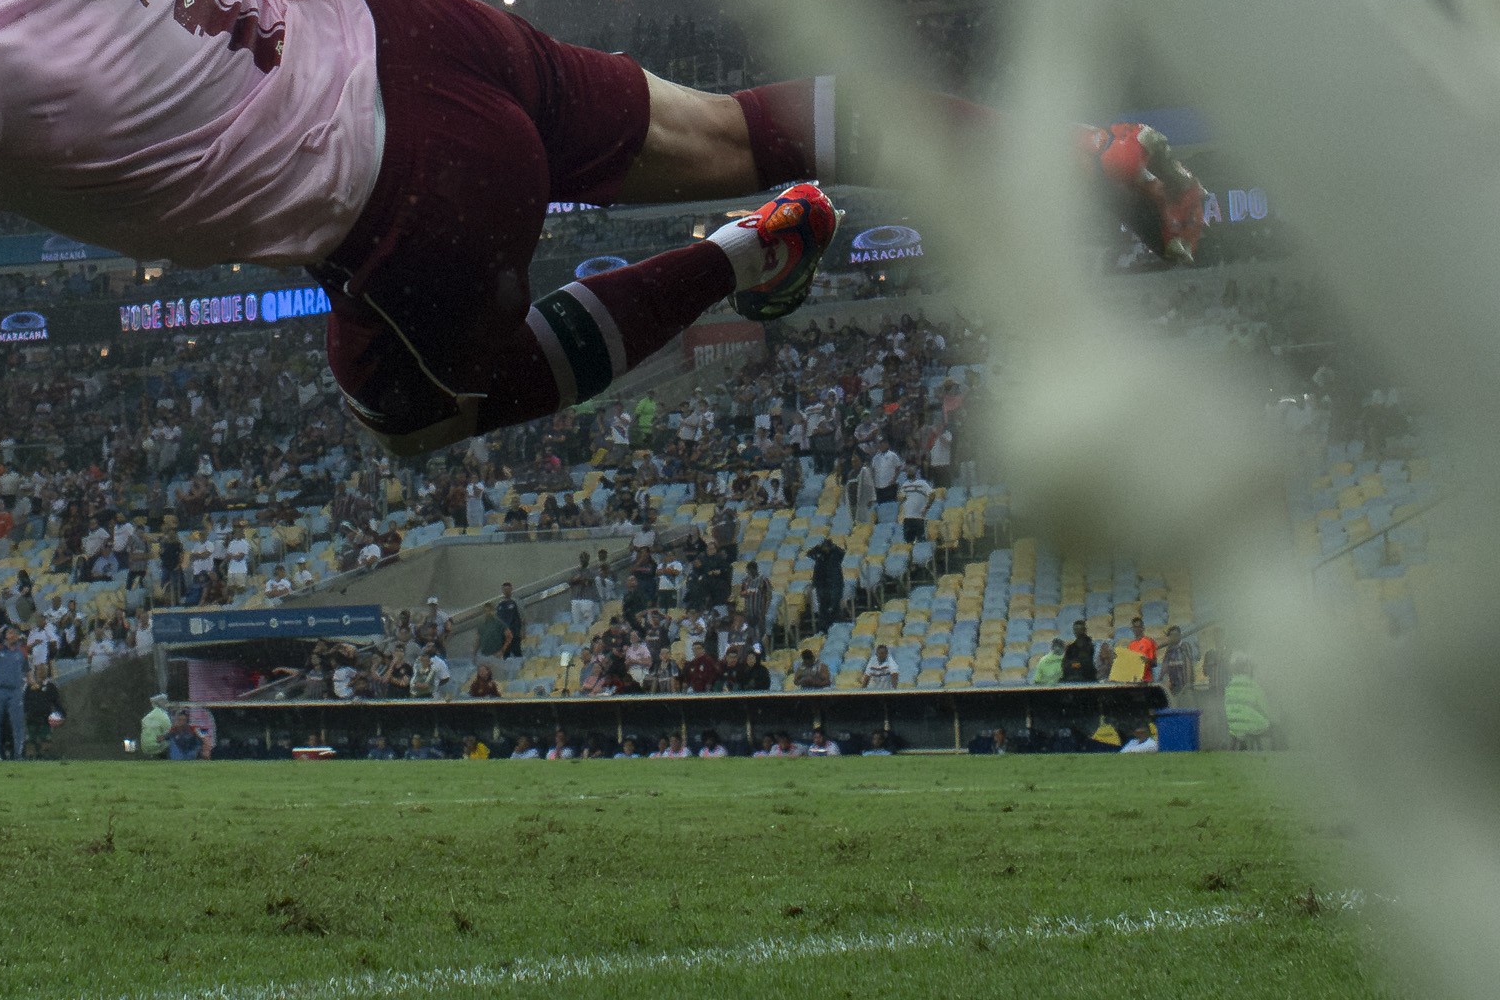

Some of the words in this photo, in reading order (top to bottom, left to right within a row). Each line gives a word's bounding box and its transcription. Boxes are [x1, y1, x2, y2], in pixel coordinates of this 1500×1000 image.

[119, 300, 162, 332] VOCÊ
[164, 298, 186, 328] JÁ
[245, 292, 258, 321] O
[261, 286, 332, 323] @MARA
